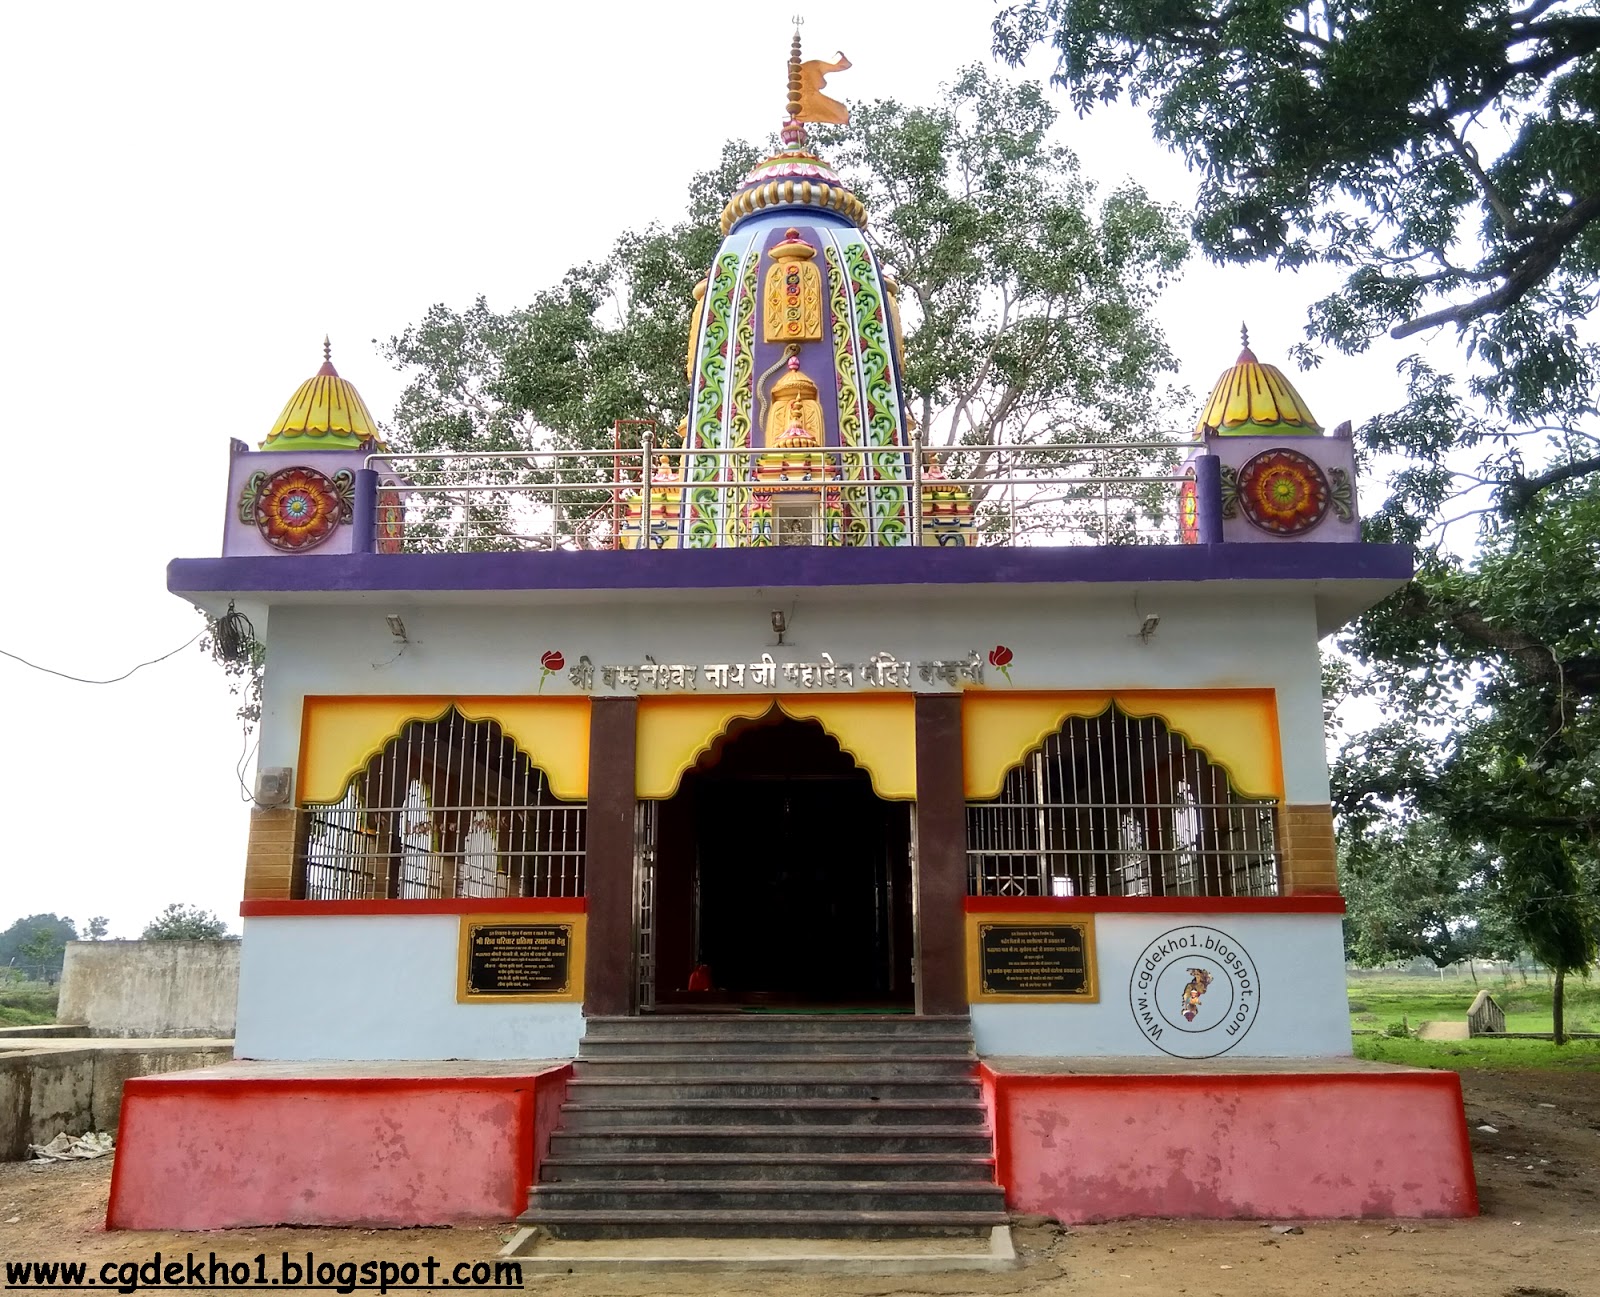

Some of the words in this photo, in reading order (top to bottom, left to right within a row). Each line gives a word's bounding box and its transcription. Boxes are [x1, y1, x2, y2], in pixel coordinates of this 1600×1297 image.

[568, 655, 595, 690] श्री
[703, 663, 746, 688] नाथ
[750, 652, 777, 688] जी
[782, 652, 854, 688] महादेव
[859, 651, 911, 688] मंदिर
